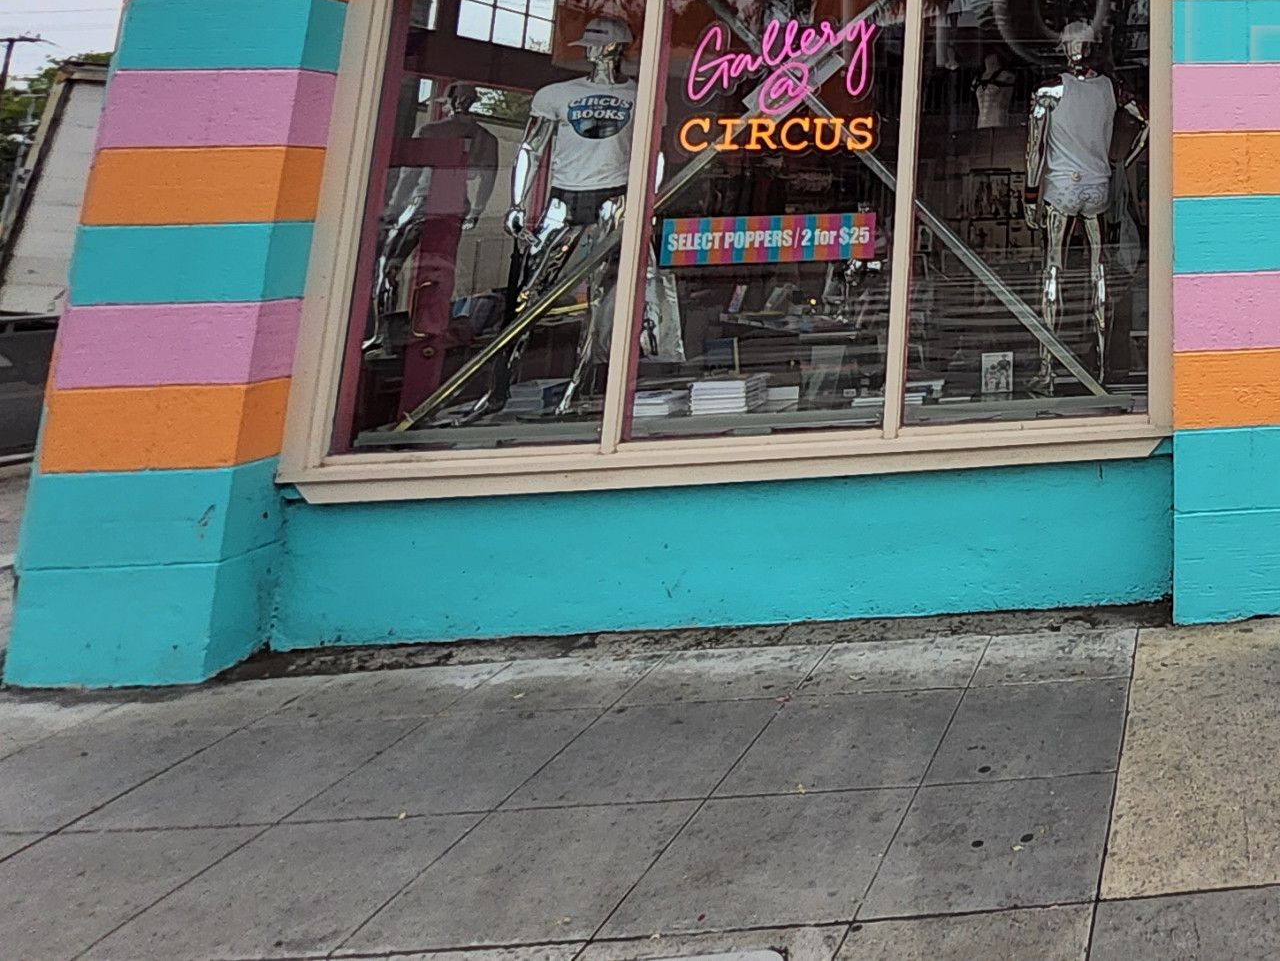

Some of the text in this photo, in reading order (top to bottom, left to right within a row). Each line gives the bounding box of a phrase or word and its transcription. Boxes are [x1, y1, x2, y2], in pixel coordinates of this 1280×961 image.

[687, 18, 876, 101] Gallery
[569, 96, 632, 109] CIRCUS
[758, 61, 810, 115] @
[571, 108, 626, 120] BOOKS
[679, 116, 874, 153] CIRCUS
[667, 232, 723, 251] SELECT
[724, 228, 793, 249] POPPERS
[801, 228, 813, 246] 2
[813, 227, 837, 245] for
[838, 226, 870, 246] $25
